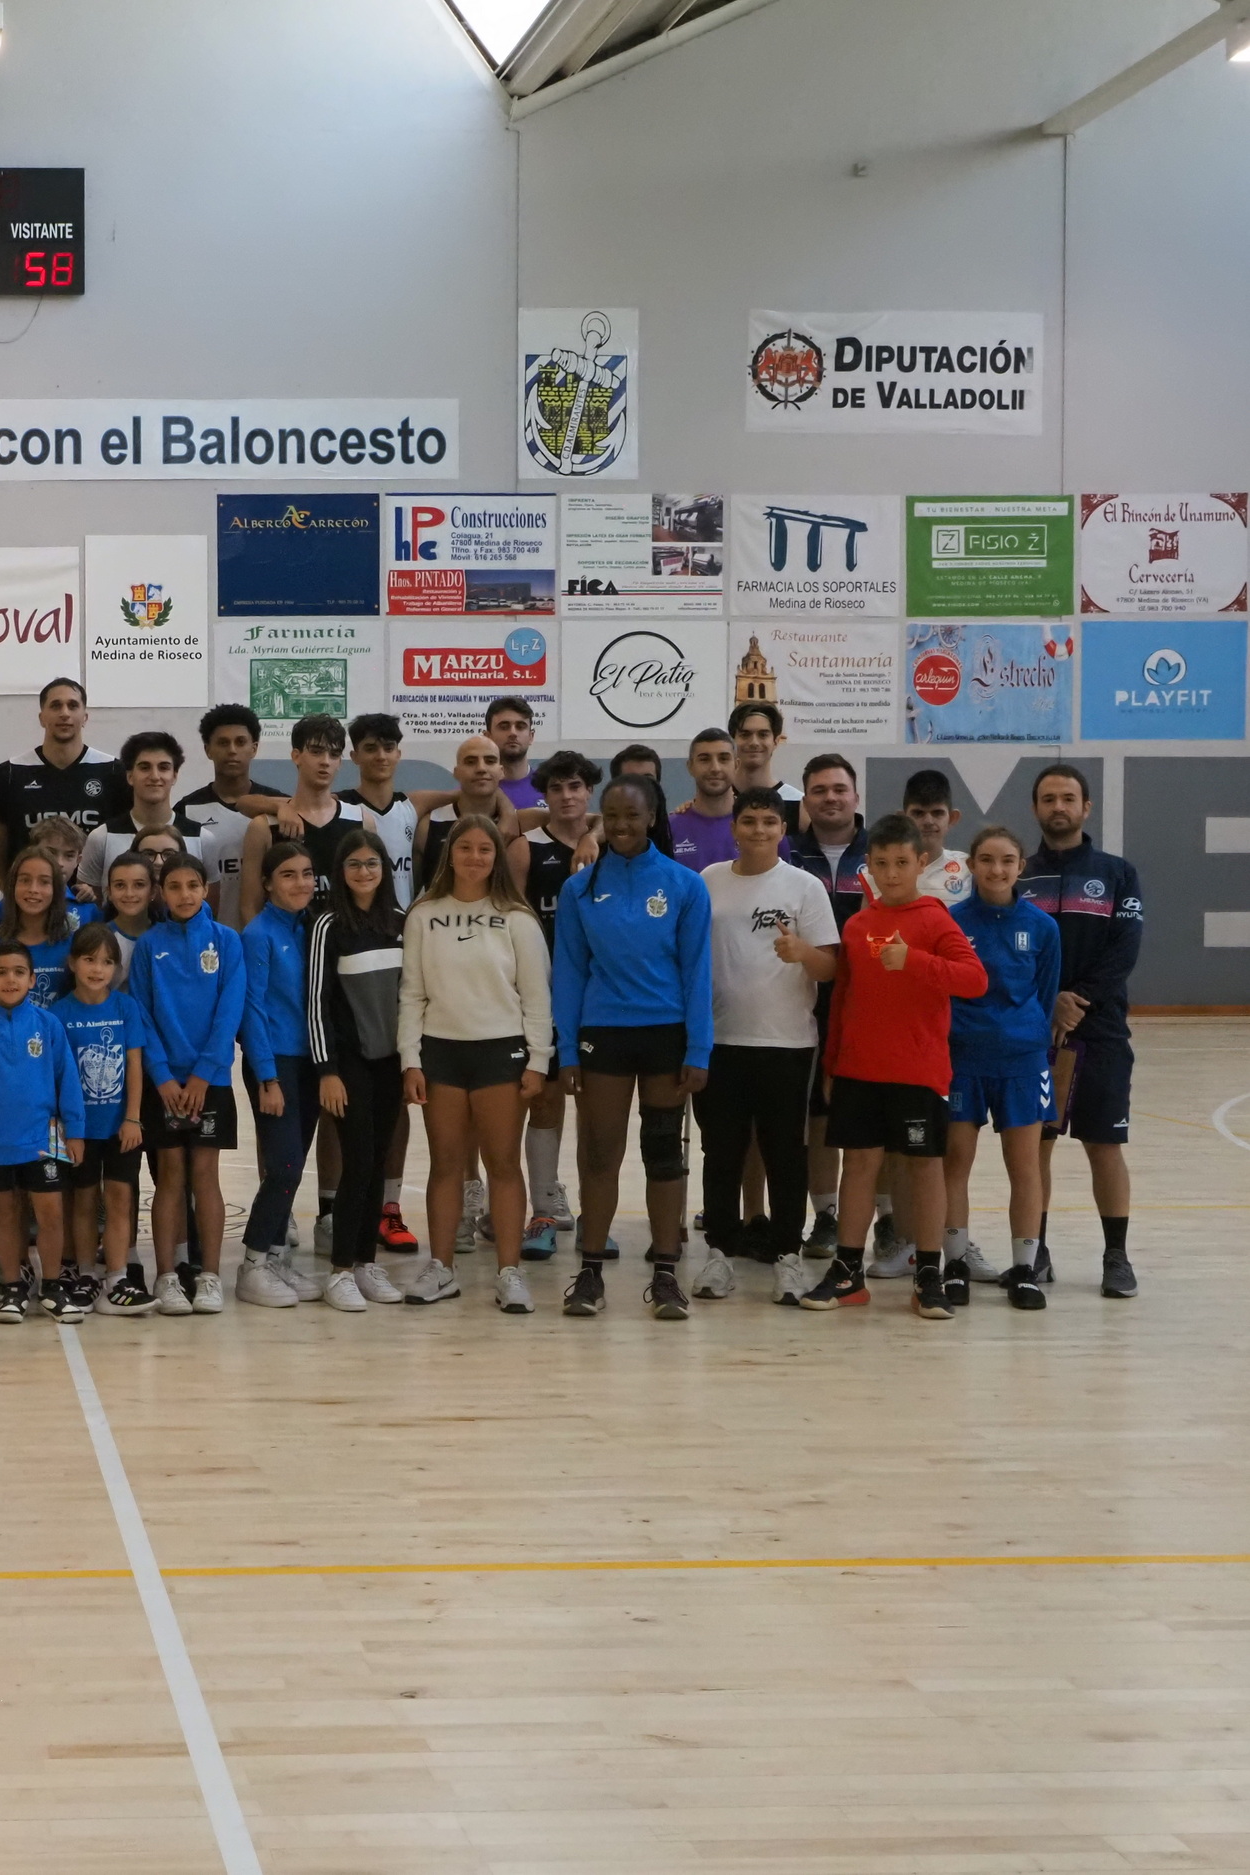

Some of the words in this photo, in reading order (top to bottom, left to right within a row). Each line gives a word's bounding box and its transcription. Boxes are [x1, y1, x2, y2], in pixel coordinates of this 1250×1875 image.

[11, 223, 73, 238] VISITANTE
[25, 252, 74, 286] 58
[832, 387, 865, 408] DE
[568, 388, 586, 442] ALMIRANTES
[100, 416, 140, 465] el
[163, 415, 447, 466] Baloncesto
[451, 506, 546, 528] Construcciones
[1104, 503, 1116, 522] El
[1122, 503, 1161, 522] Rincón
[1164, 505, 1176, 522] de
[1179, 503, 1236, 522] Unamuno
[970, 535, 1018, 549] FISIO
[390, 572, 412, 588] Hnos.
[415, 572, 462, 588] PINTADO
[1129, 564, 1194, 583] Cervecería
[737, 581, 794, 592] FARMACIA
[797, 581, 819, 592] LOS
[823, 582, 896, 592] SOPORTALES
[769, 598, 806, 608] Medina
[809, 598, 821, 608] de
[825, 598, 865, 608] Rioseco
[243, 625, 355, 641] Farmacia
[771, 630, 847, 642] Restaurante
[96, 636, 180, 648] Ayuntamiento
[185, 636, 199, 645] de
[91, 651, 135, 660] Medina
[140, 651, 153, 660] de
[158, 650, 202, 660] Rioseco
[229, 646, 248, 654] Lda.
[252, 646, 288, 655] Myriam
[292, 646, 333, 654] Gutiérrez
[337, 646, 371, 655] Laguna
[788, 652, 893, 668] Santamaría
[513, 670, 536, 678] S.L.
[589, 664, 626, 696] El
[628, 660, 698, 693] Patio
[1115, 690, 1211, 706] PLAYFIT
[430, 914, 506, 931] NIKE
